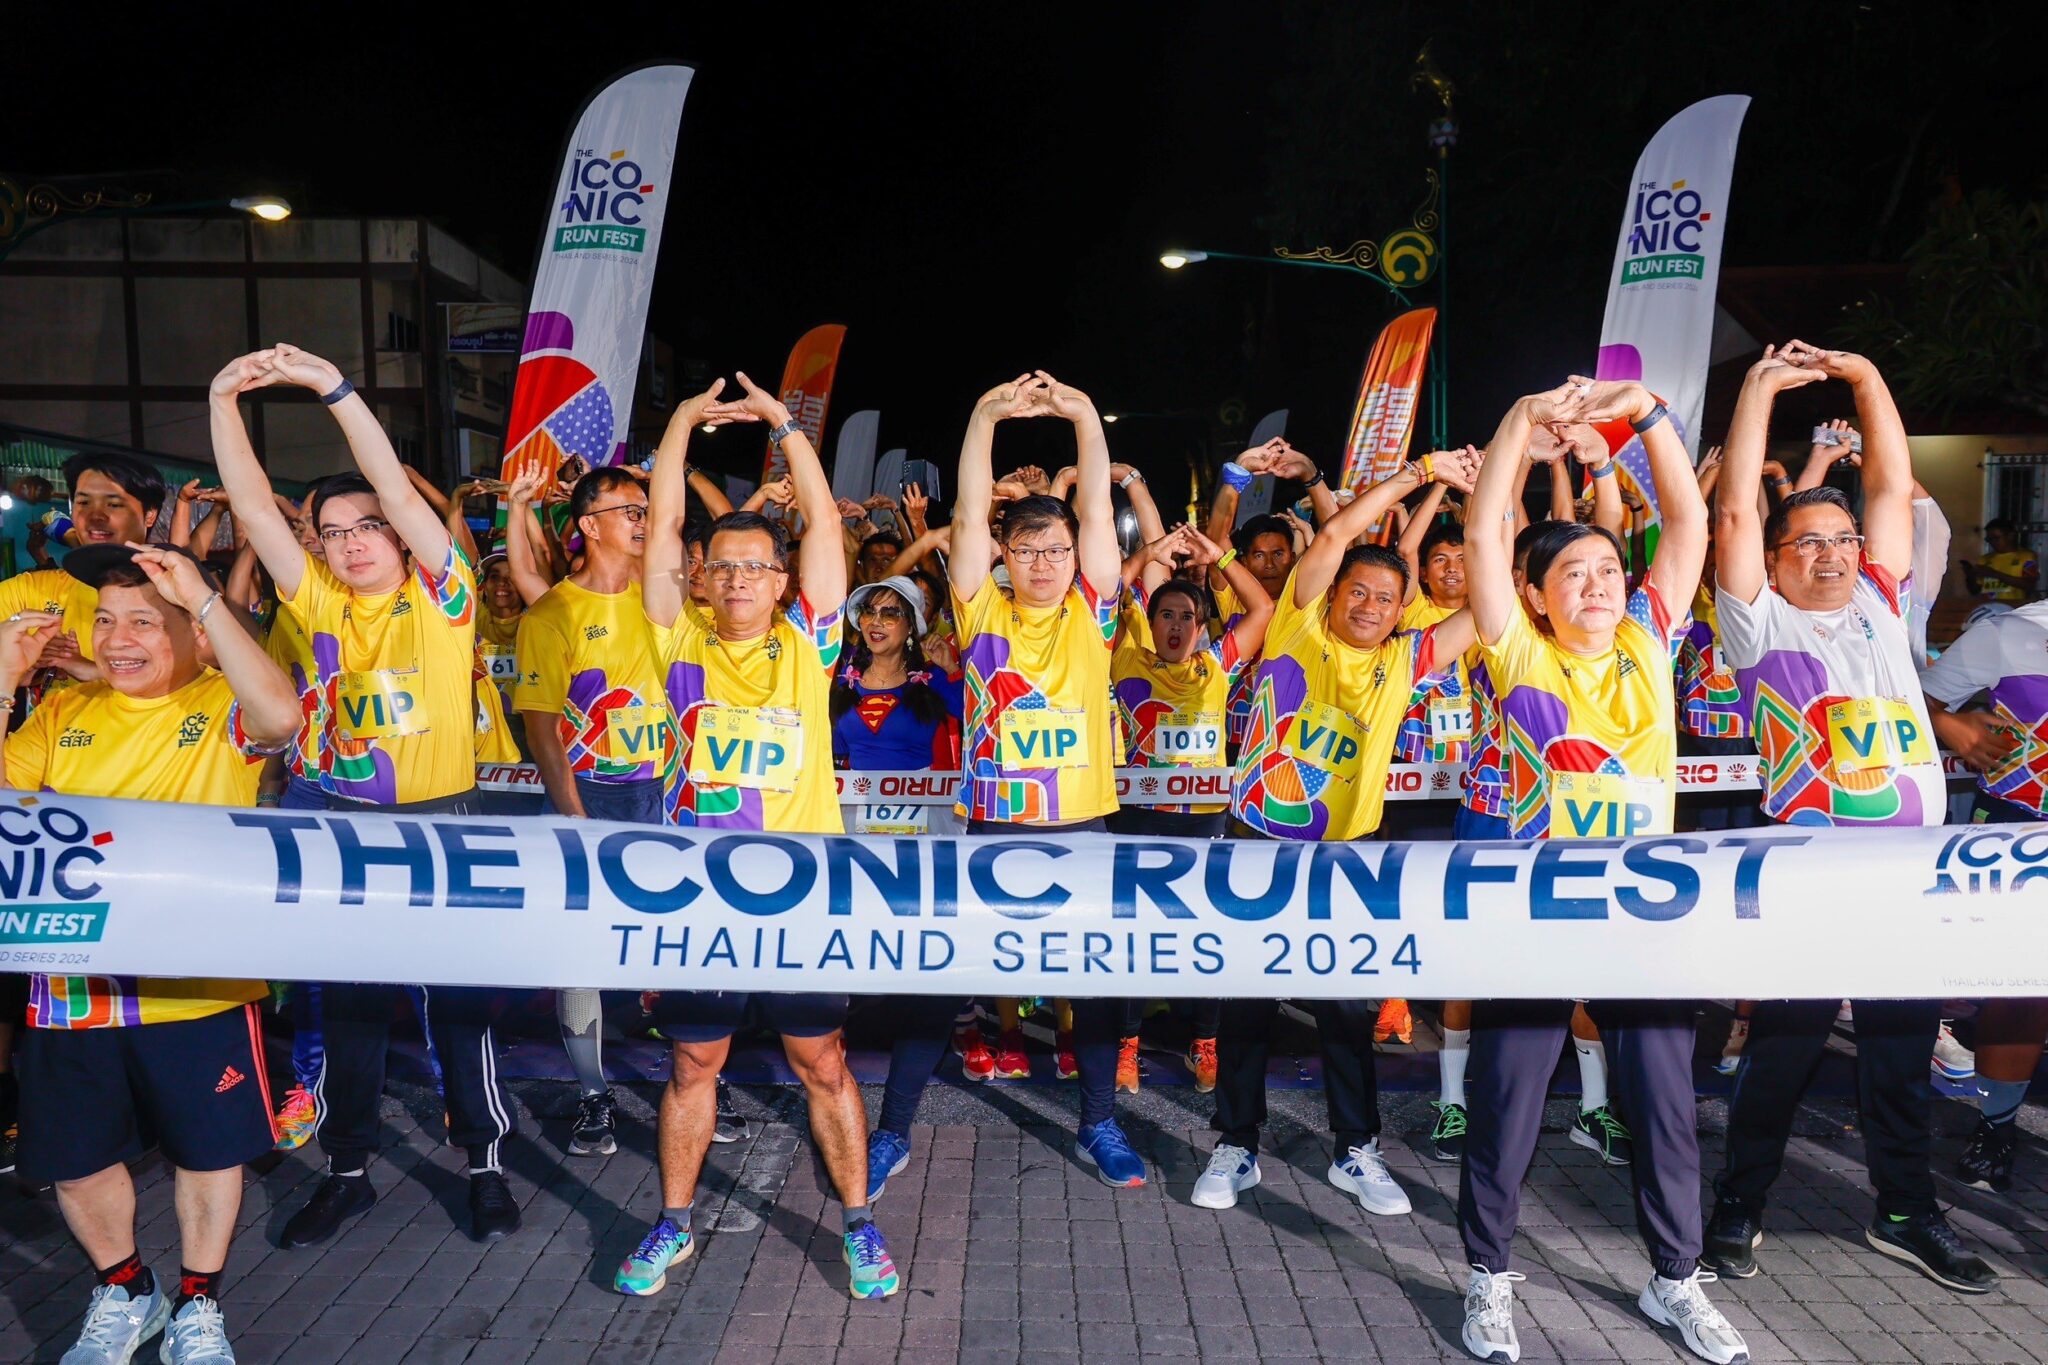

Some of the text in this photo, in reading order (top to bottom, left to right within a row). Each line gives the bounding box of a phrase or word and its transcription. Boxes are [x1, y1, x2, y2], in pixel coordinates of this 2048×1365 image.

[577, 149, 593, 157] THE
[570, 158, 643, 190] ICO
[1640, 182, 1656, 190] THE
[565, 191, 645, 225] NIC
[1634, 190, 1701, 224] ICO
[562, 229, 639, 248] RUN FEST
[1631, 220, 1703, 255] NIC
[1629, 259, 1699, 275] RUN FEST
[484, 658, 514, 674] 61
[342, 691, 414, 728] VIP
[1010, 728, 1078, 760] VIP
[1162, 730, 1217, 750] 1019
[1299, 718, 1358, 766] VIP
[1840, 720, 1918, 758] VIP
[706, 735, 786, 776] VIP
[865, 804, 922, 820] 1677
[1564, 799, 1653, 837] VIP
[230, 812, 1813, 921] THE ICONIC RUN FEST
[33, 912, 96, 936] FEST
[13, 952, 55, 964] SERIES
[59, 953, 90, 964] 2024
[610, 924, 1422, 975] THAILAND SERIES 2024
[215, 1073, 245, 1092] adidas
